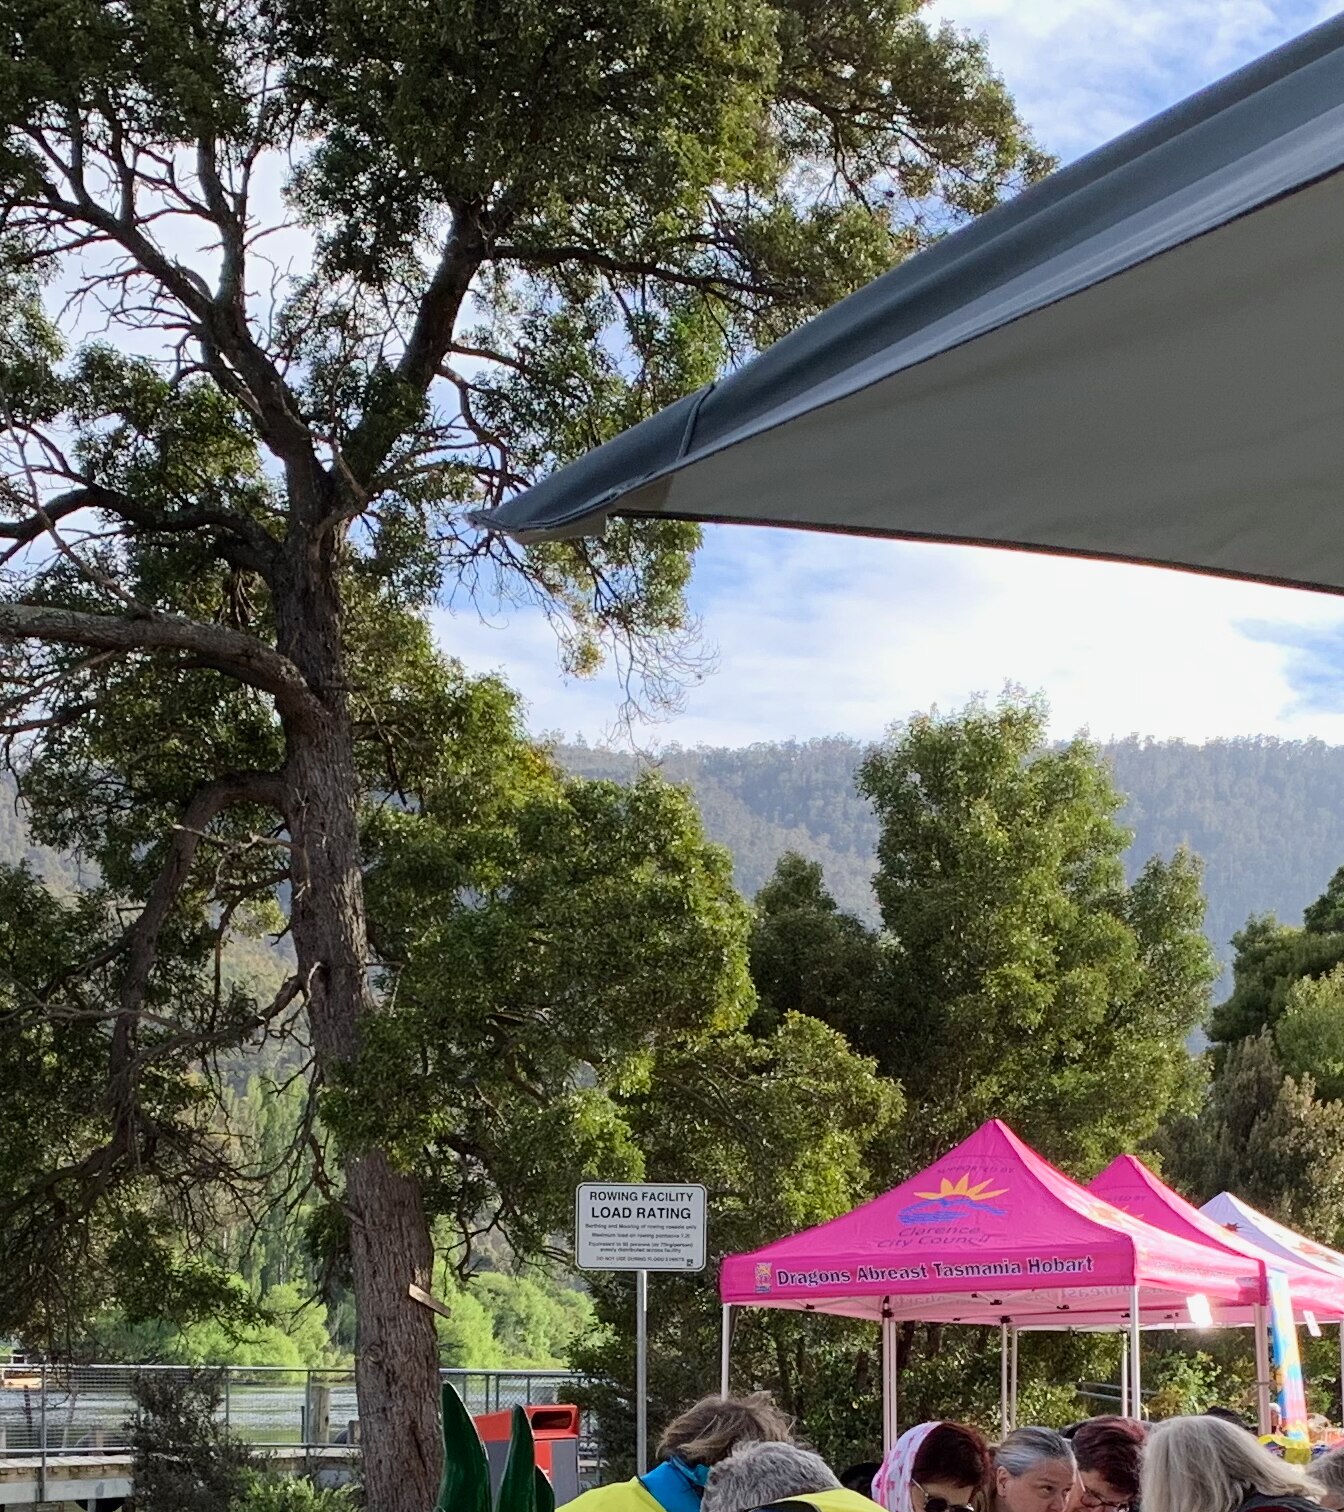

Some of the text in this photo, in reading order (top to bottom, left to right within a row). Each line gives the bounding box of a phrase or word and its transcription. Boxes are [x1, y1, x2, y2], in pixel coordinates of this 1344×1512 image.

[589, 1191, 694, 1202] ROWING FACILITY
[591, 1207, 692, 1220] LOAD RATING
[898, 1226, 981, 1238] Clarence
[877, 1233, 990, 1248] City Council
[776, 1255, 1094, 1287] Dragons Abreast Tasmania Hobart
